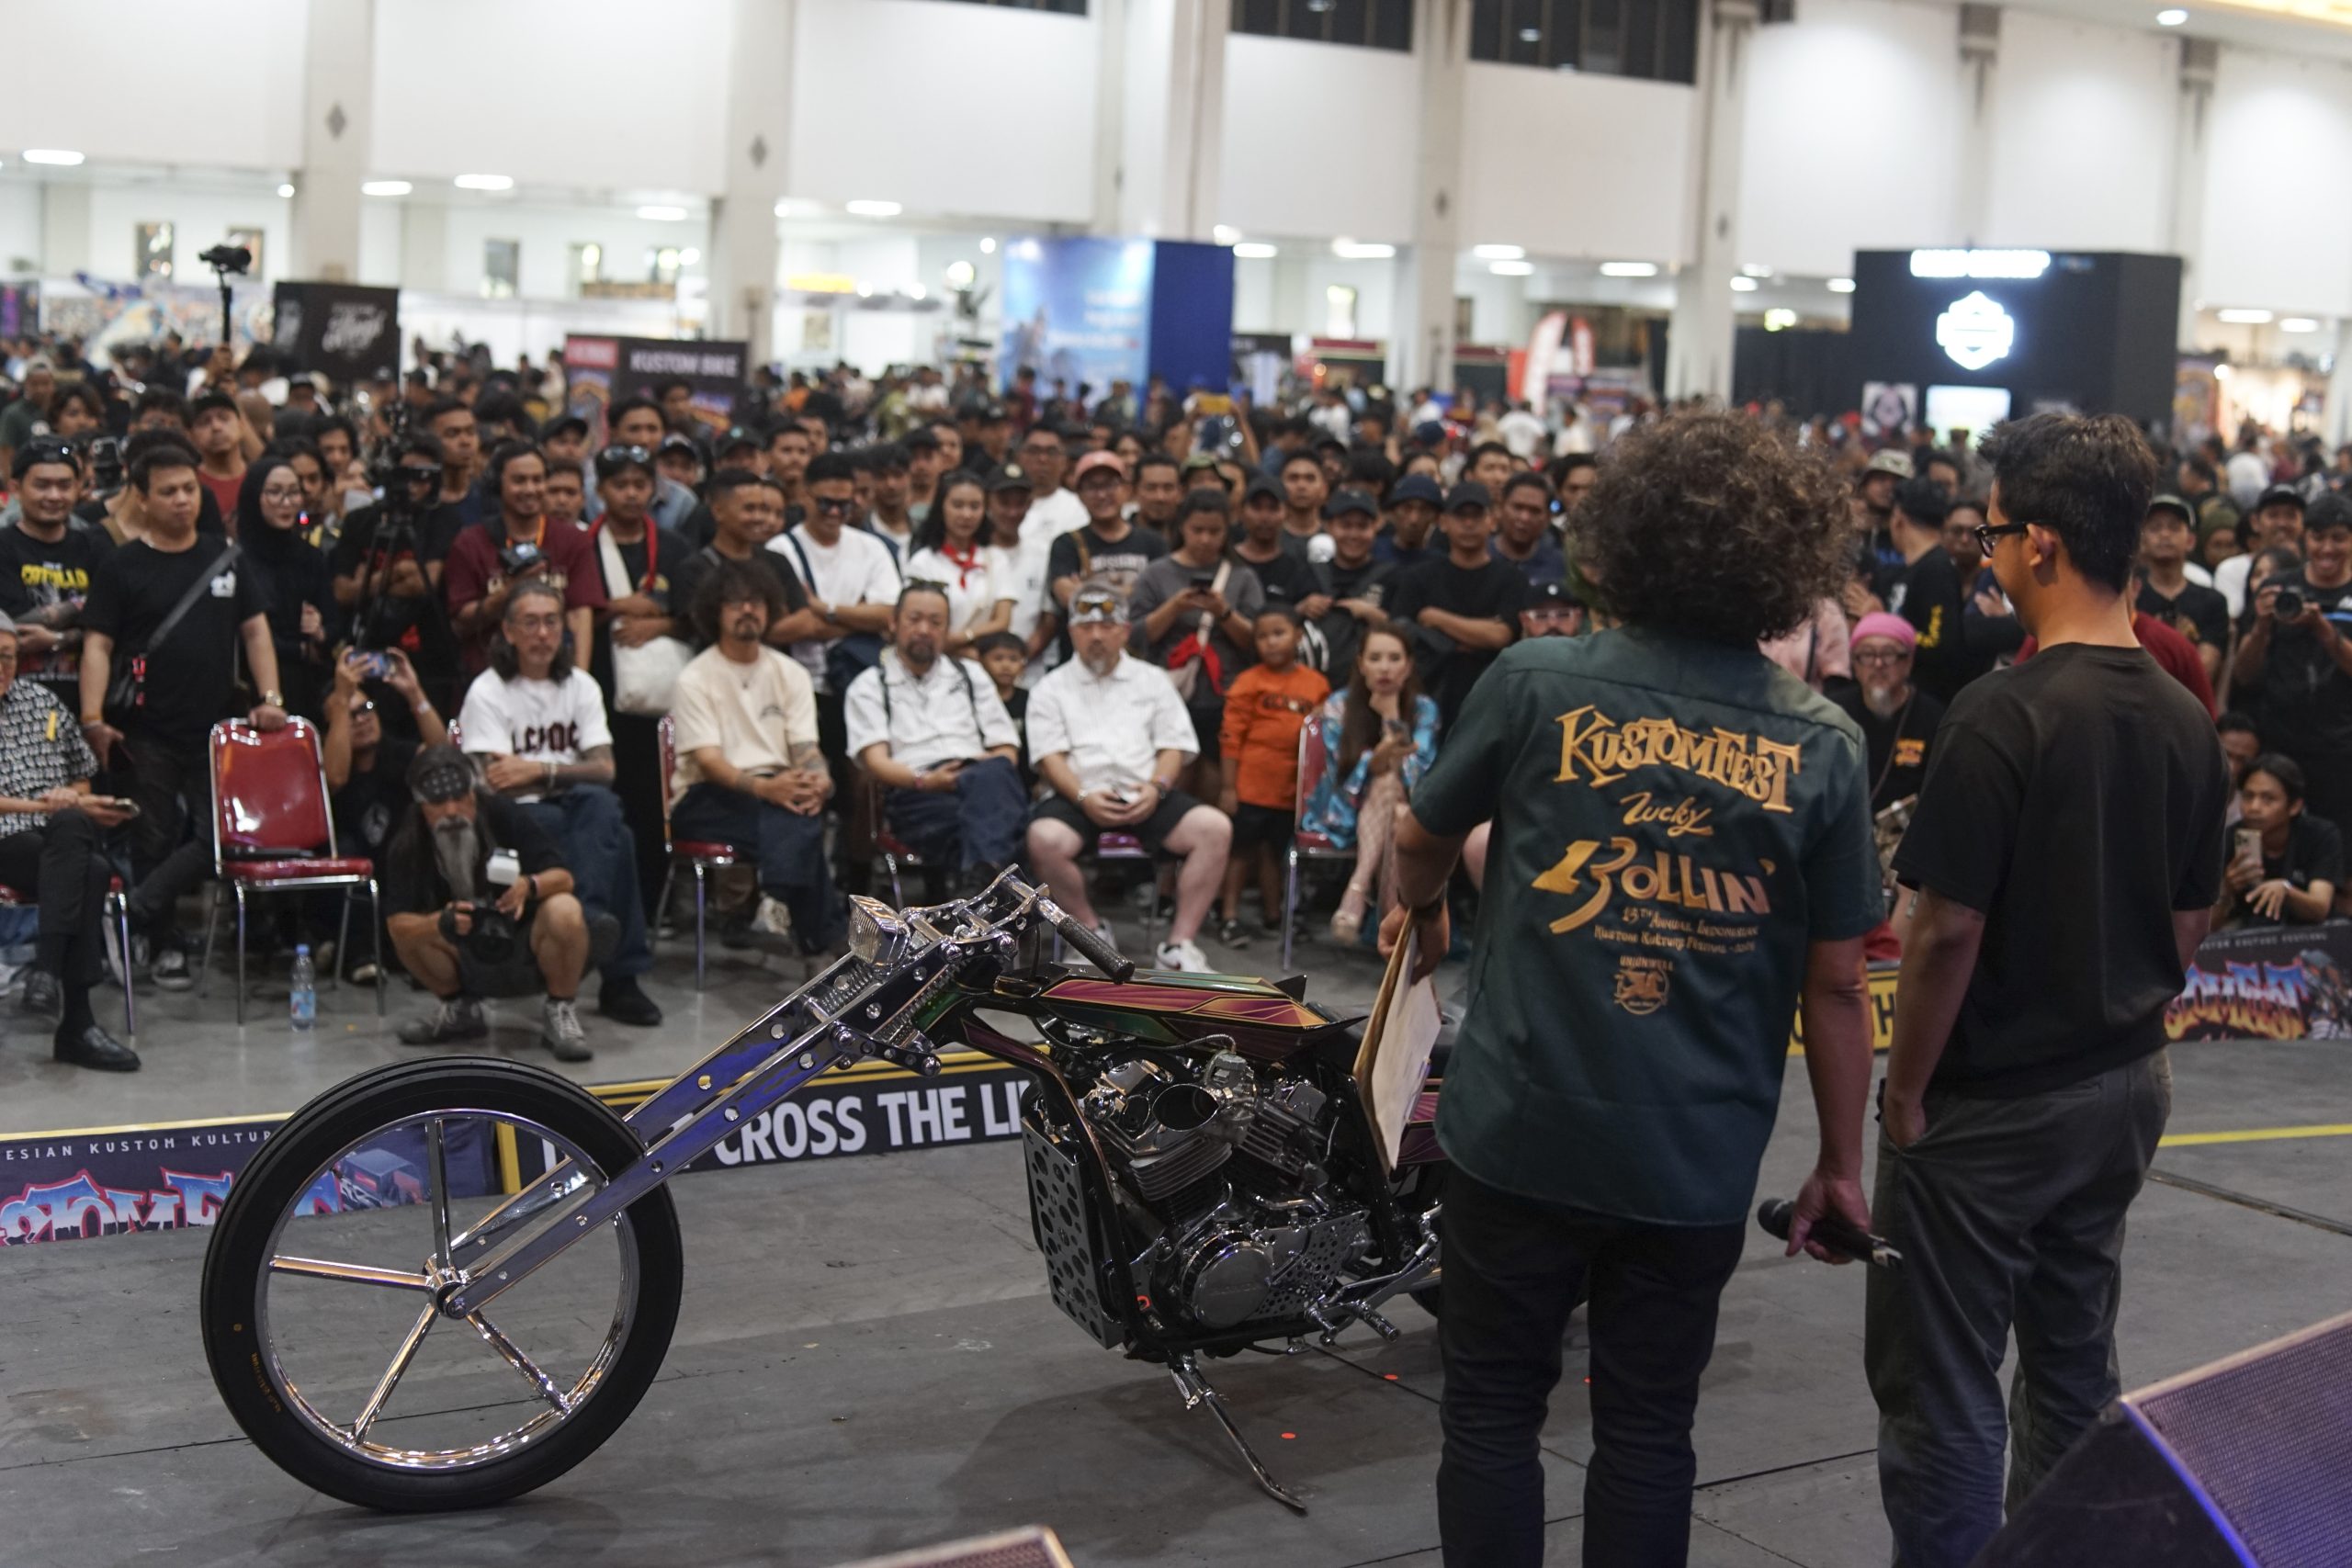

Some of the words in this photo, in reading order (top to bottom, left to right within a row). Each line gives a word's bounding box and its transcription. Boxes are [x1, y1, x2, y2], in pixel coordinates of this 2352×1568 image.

[877, 1086, 972, 1146] THE
[6, 1145, 74, 1161] ESIAN
[90, 1137, 175, 1156] KUSTOM
